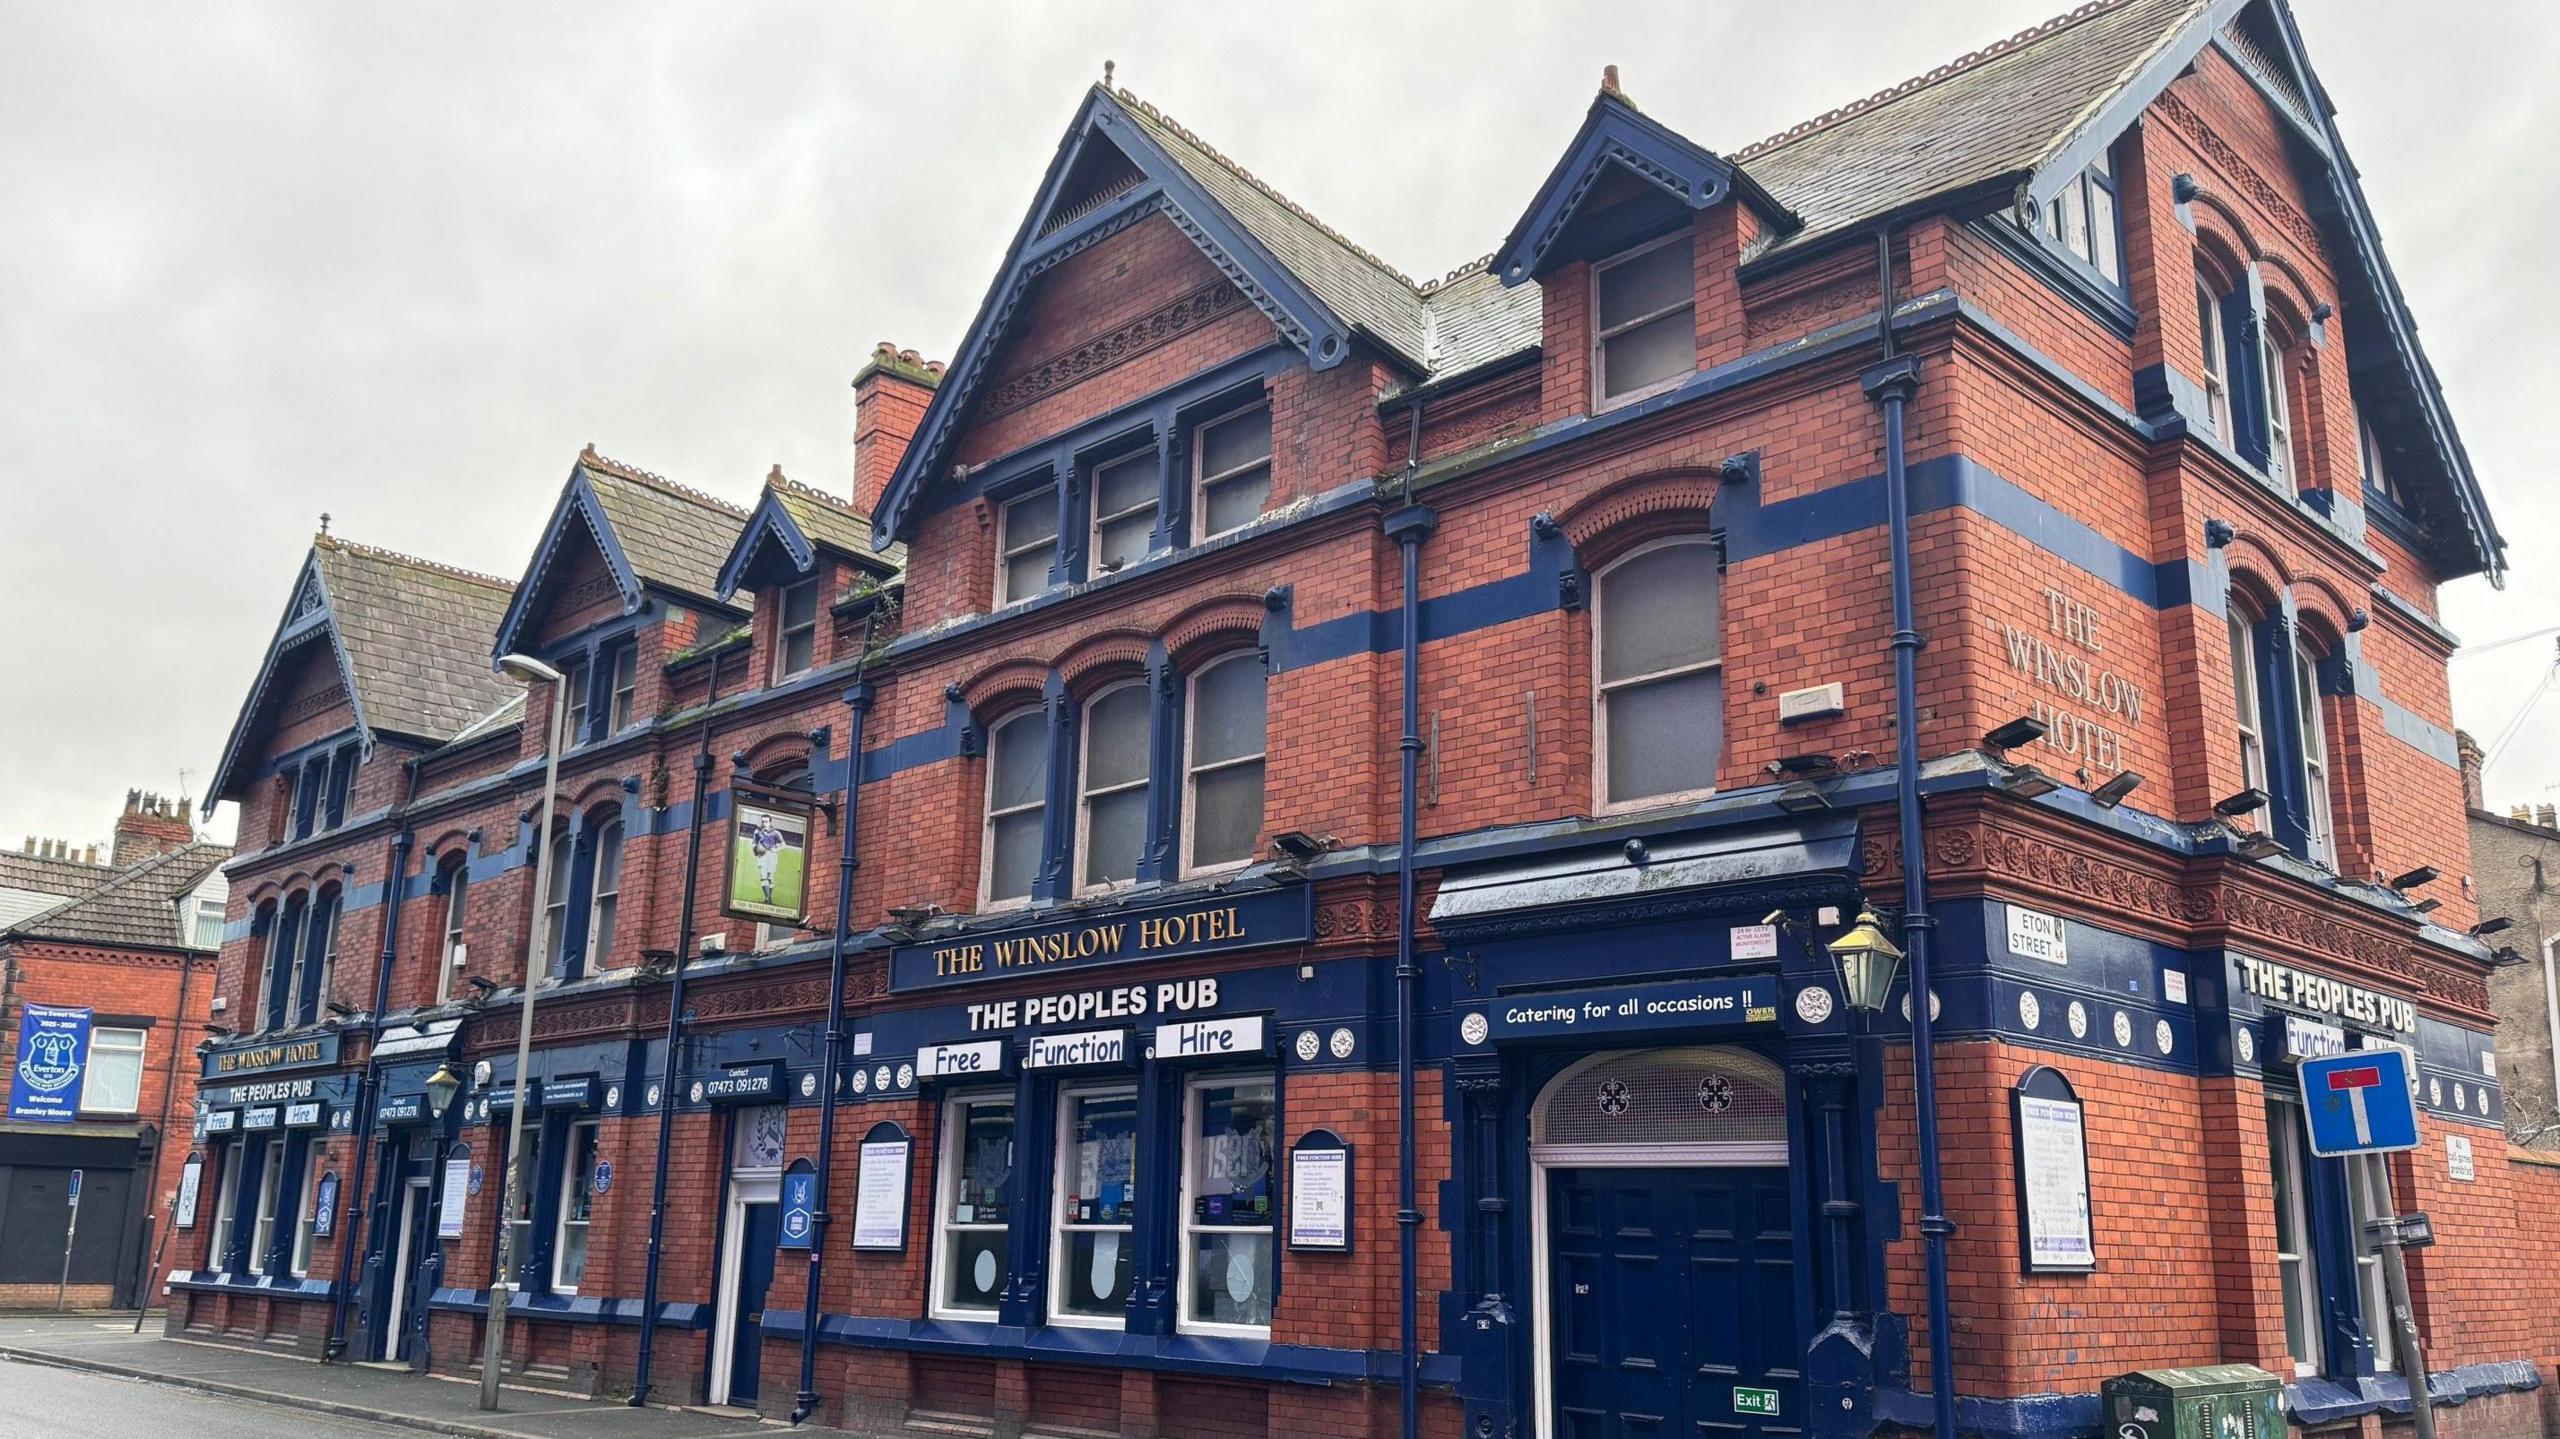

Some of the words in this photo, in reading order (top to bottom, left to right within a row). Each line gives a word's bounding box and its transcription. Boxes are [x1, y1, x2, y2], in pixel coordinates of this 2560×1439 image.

[2044, 586, 2102, 650] THE
[2003, 623, 2144, 726] WINSLOW
[2022, 913, 2050, 935] ETON
[933, 945, 983, 976] THE
[994, 923, 1127, 968] WINSLOW
[1139, 907, 1246, 949] HOTEL
[2012, 933, 2052, 957] STREET
[2055, 949, 2064, 961] L4
[968, 1001, 1016, 1031] THE
[1024, 986, 1147, 1026] PEOPLES
[1157, 978, 1218, 1013] PUB
[1506, 1006, 1575, 1024] Catering
[1583, 1001, 1610, 1019] for
[1618, 998, 1639, 1015] all
[1649, 995, 1733, 1013] occasions
[1742, 990, 1752, 1008] !!
[2244, 957, 2288, 1001] THE
[2292, 969, 2377, 1023] PEOPLES
[2380, 995, 2415, 1033] PUB
[1180, 1023, 1233, 1054] Hire
[2286, 1017, 2345, 1054] Function
[219, 1055, 236, 1071] THE
[239, 1046, 283, 1068] WINSLOW
[286, 1042, 321, 1062] HOTEL
[935, 1047, 981, 1073] Free
[1031, 1038, 1121, 1067] Function
[34, 1065, 64, 1073] Everton
[230, 1087, 247, 1103] THE
[248, 1082, 290, 1101] PEOPLES
[291, 1080, 312, 1097] PUB
[708, 1080, 734, 1094] 07473
[736, 1077, 768, 1092] 091278
[29, 1095, 63, 1104] Welcome
[211, 1114, 227, 1128] Free
[244, 1110, 274, 1127] Function
[293, 1104, 310, 1121] Hire
[1736, 1393, 1761, 1407] Exit
